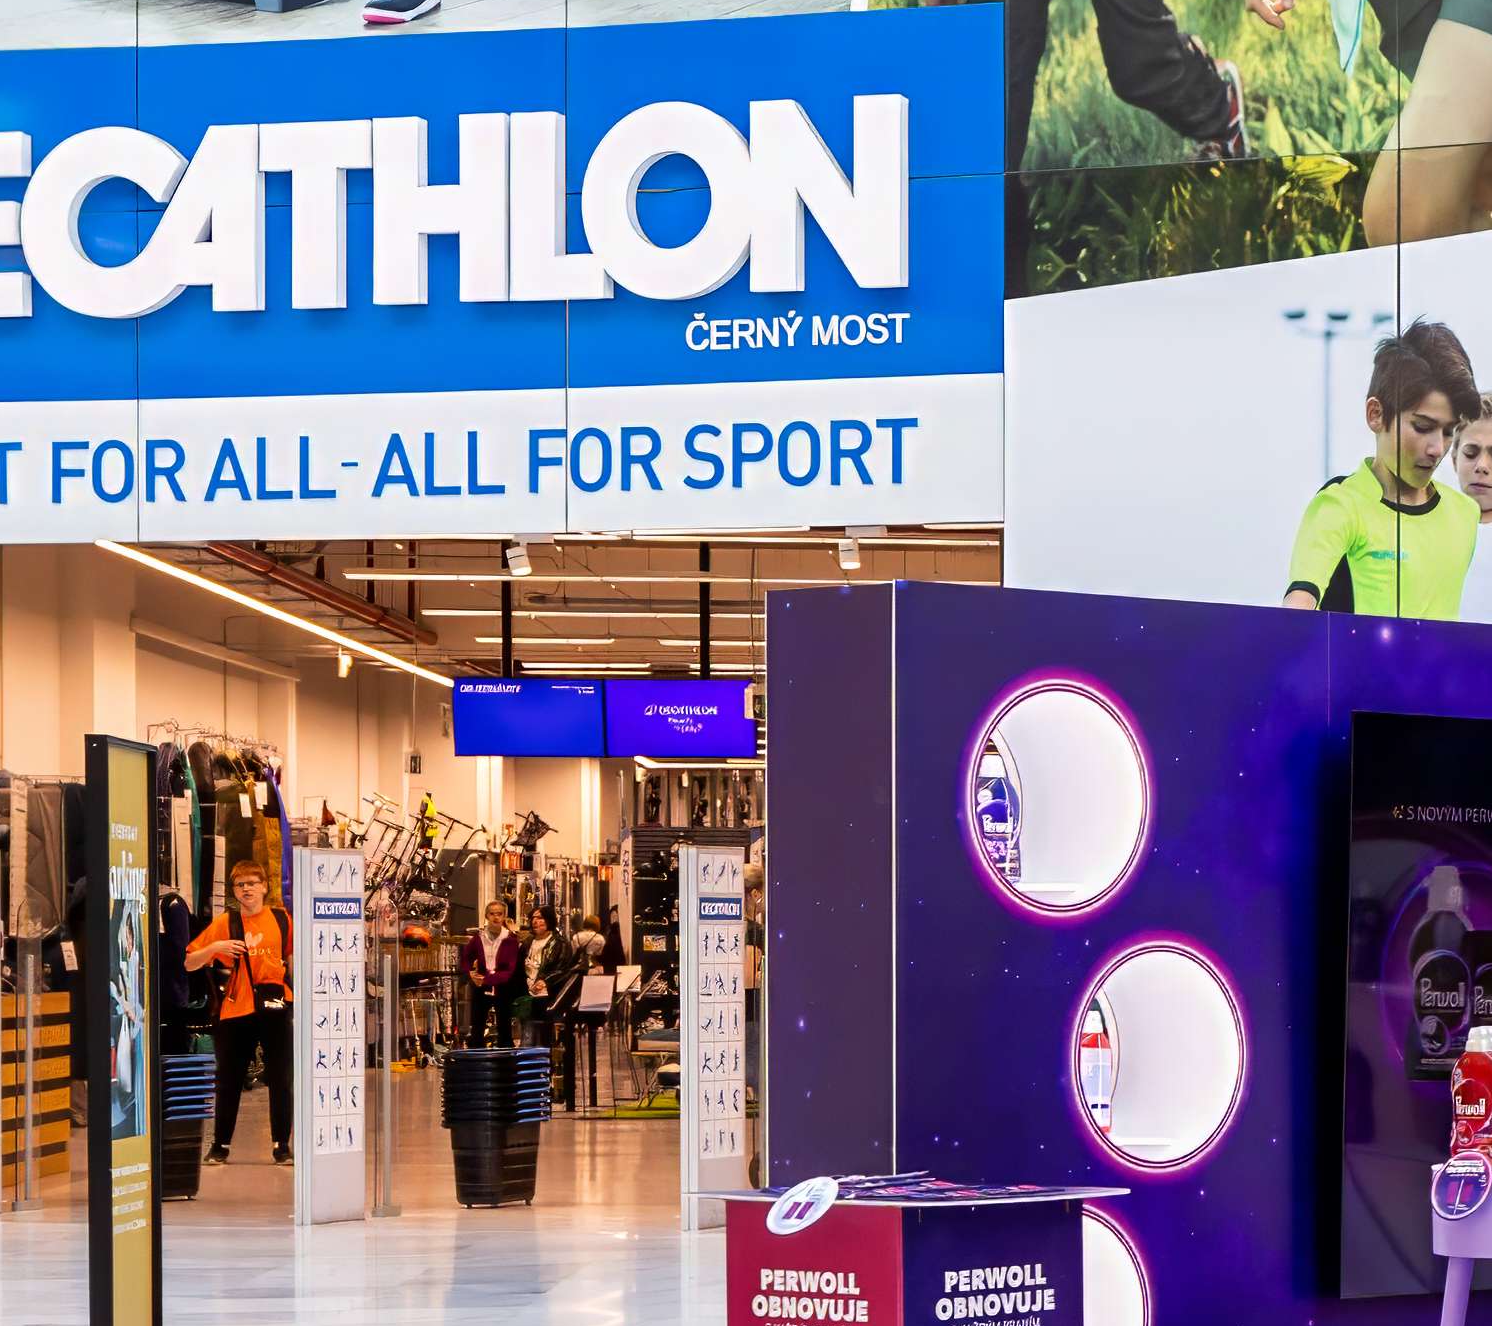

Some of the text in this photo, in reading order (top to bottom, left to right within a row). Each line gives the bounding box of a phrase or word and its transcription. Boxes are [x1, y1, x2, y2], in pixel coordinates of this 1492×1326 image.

[684, 310, 911, 352] ČERNÝ MOST
[51, 438, 186, 505] FOR
[204, 435, 337, 502] ALL
[371, 431, 506, 499] ALL
[528, 426, 663, 494] FOR
[683, 417, 919, 490] SPORT
[1406, 805, 1415, 821] S
[1417, 804, 1463, 822] NOVÝM
[1419, 977, 1466, 1008] Perwoll
[760, 1268, 861, 1296] PERWOLL
[944, 1263, 1048, 1293] PERWOLL
[751, 1294, 869, 1323] OBNOVUJE
[935, 1288, 1056, 1321] OBNOVUJE
